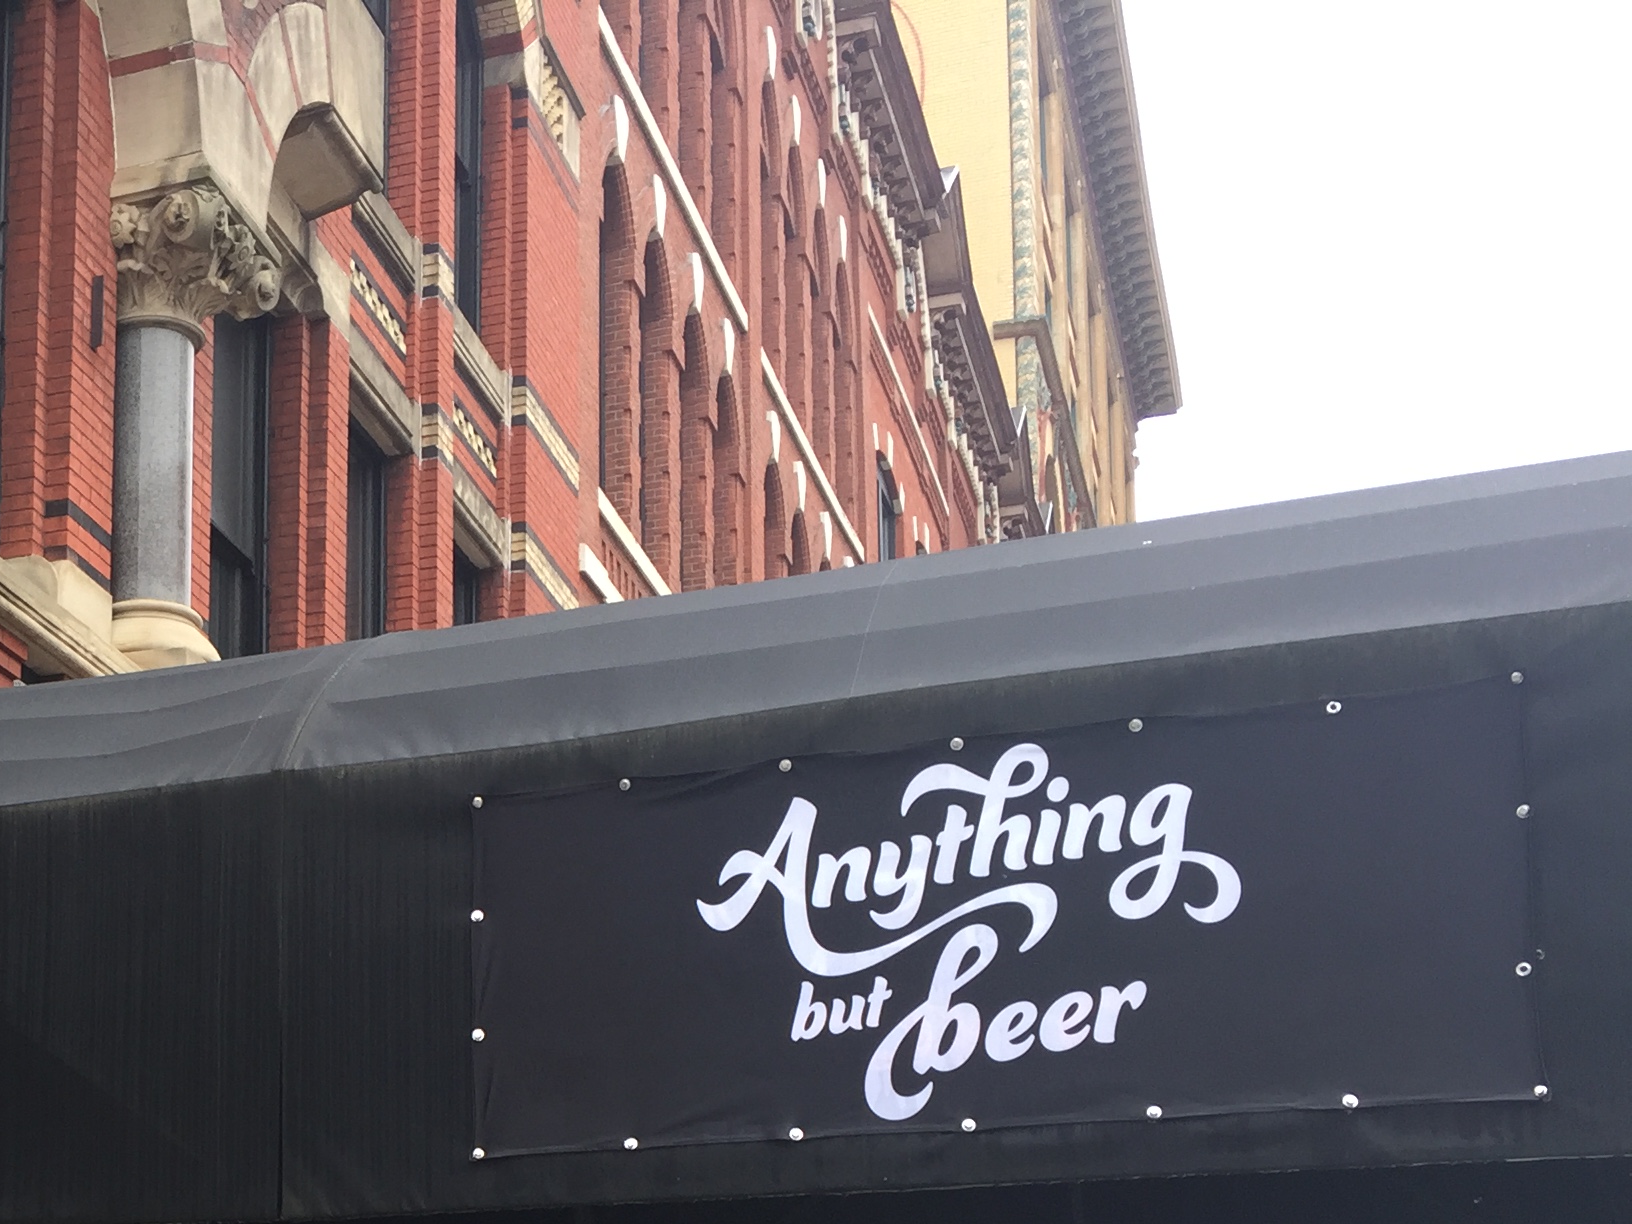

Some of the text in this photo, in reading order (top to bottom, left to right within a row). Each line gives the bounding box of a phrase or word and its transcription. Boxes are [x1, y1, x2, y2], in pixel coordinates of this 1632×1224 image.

[696, 742, 1242, 976] Anything
[791, 923, 1147, 1121] but beer
